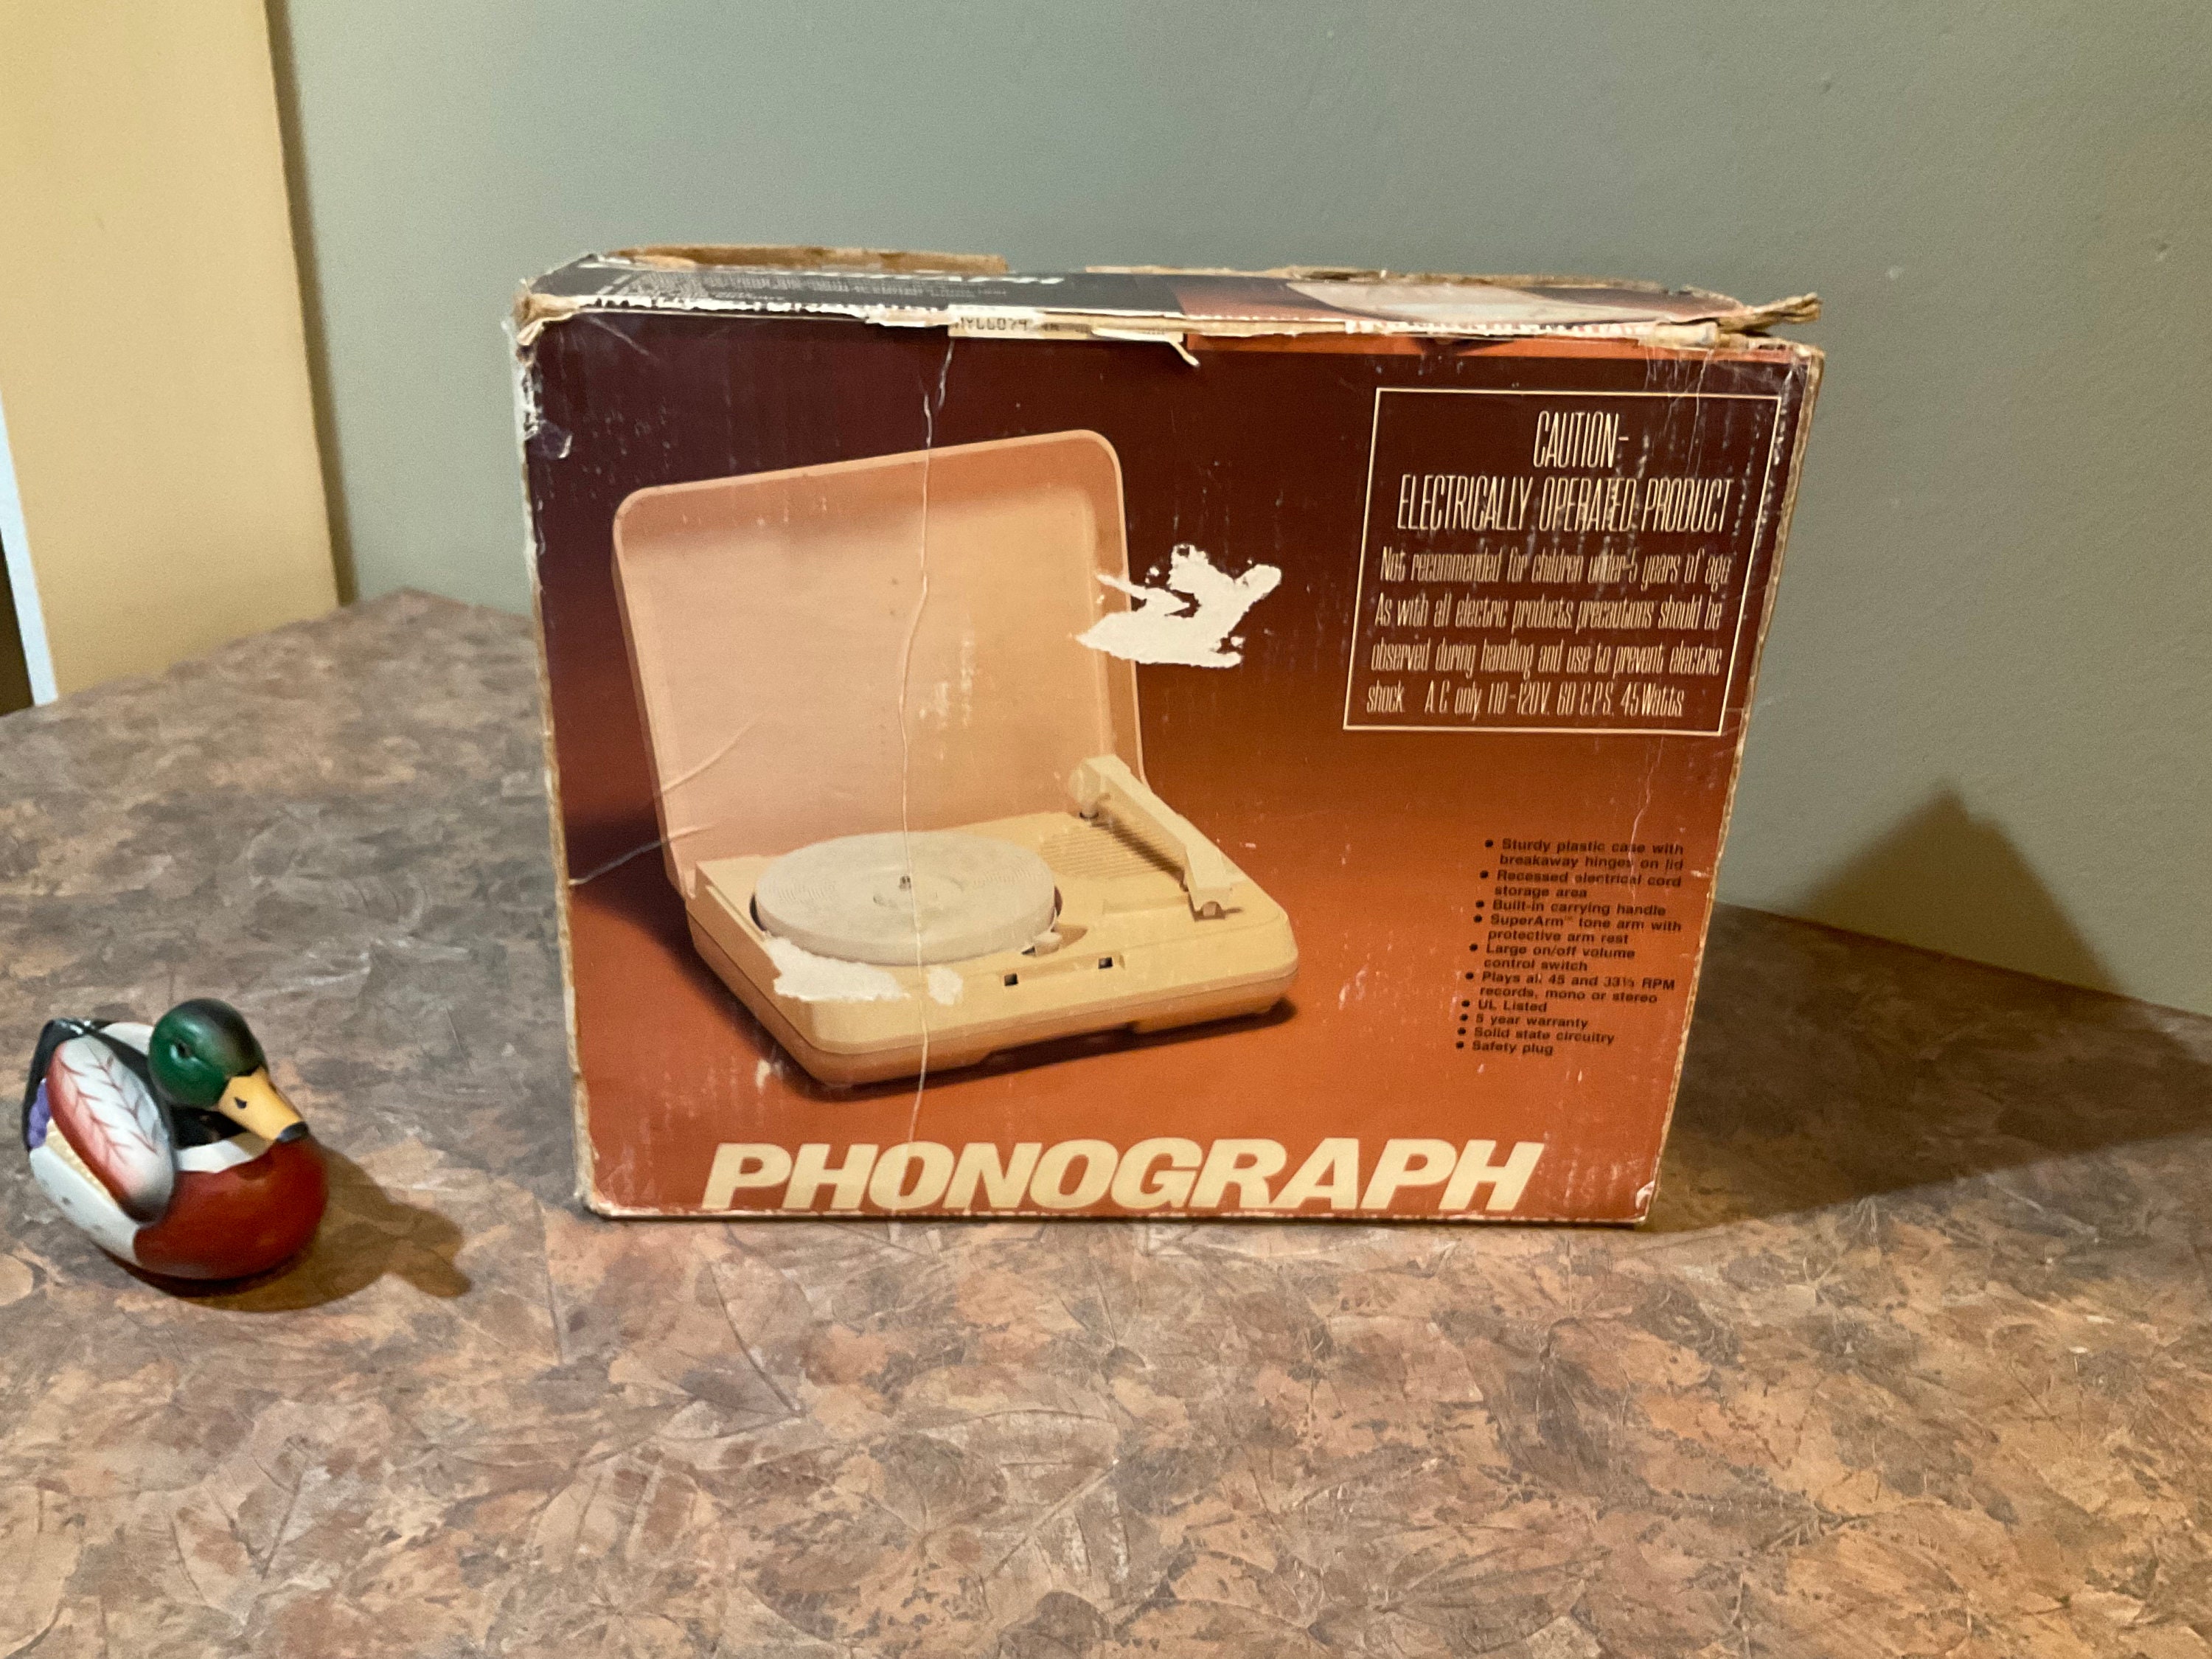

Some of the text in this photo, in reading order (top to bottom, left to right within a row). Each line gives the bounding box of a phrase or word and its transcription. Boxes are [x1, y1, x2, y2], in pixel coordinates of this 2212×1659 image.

[1397, 474, 1733, 532] ELECTRICALLY OPERATED PRODUCT
[1380, 546, 1406, 582] Not
[1411, 547, 1503, 582] recommended
[1507, 546, 1528, 583] for
[1531, 547, 1584, 583] children
[1641, 554, 1680, 591] years
[1684, 548, 1705, 583] of
[1374, 592, 1722, 634] As with all electric products precautions should be
[1371, 636, 1722, 680] observed during handling and use to prevent electric
[1557, 681, 1576, 716] 60
[1502, 838, 1683, 855] Sturdy plastic case with
[1500, 855, 1683, 871] breakaway hinges on lid
[1498, 870, 1682, 887] Recessed electrical cord
[1495, 886, 1587, 900] storage area
[1550, 903, 1610, 915] carrying
[1616, 904, 1666, 915] handle
[1579, 916, 1610, 928] tone
[1616, 919, 1644, 929] arm
[1651, 921, 1681, 931] with
[1488, 929, 1629, 944] protective arm rest
[1486, 942, 1635, 959] Large on/off volume
[1484, 959, 1587, 971] control switch
[1482, 972, 1520, 985] Plays
[1548, 975, 1565, 985] 45
[1571, 975, 1598, 987] and
[1642, 978, 1675, 991] RPM
[1545, 989, 1585, 1001] mono
[1591, 991, 1607, 1001] or
[1613, 992, 1658, 1004] stereo
[1478, 999, 1547, 1012] UL Listed
[1490, 1015, 1520, 1026] year
[1526, 1017, 1588, 1030] warranty
[1475, 1026, 1615, 1046] Solid state circuitry
[1472, 1040, 1554, 1056] Safety plug
[700, 1138, 1543, 1211] PHONOGRAPH
